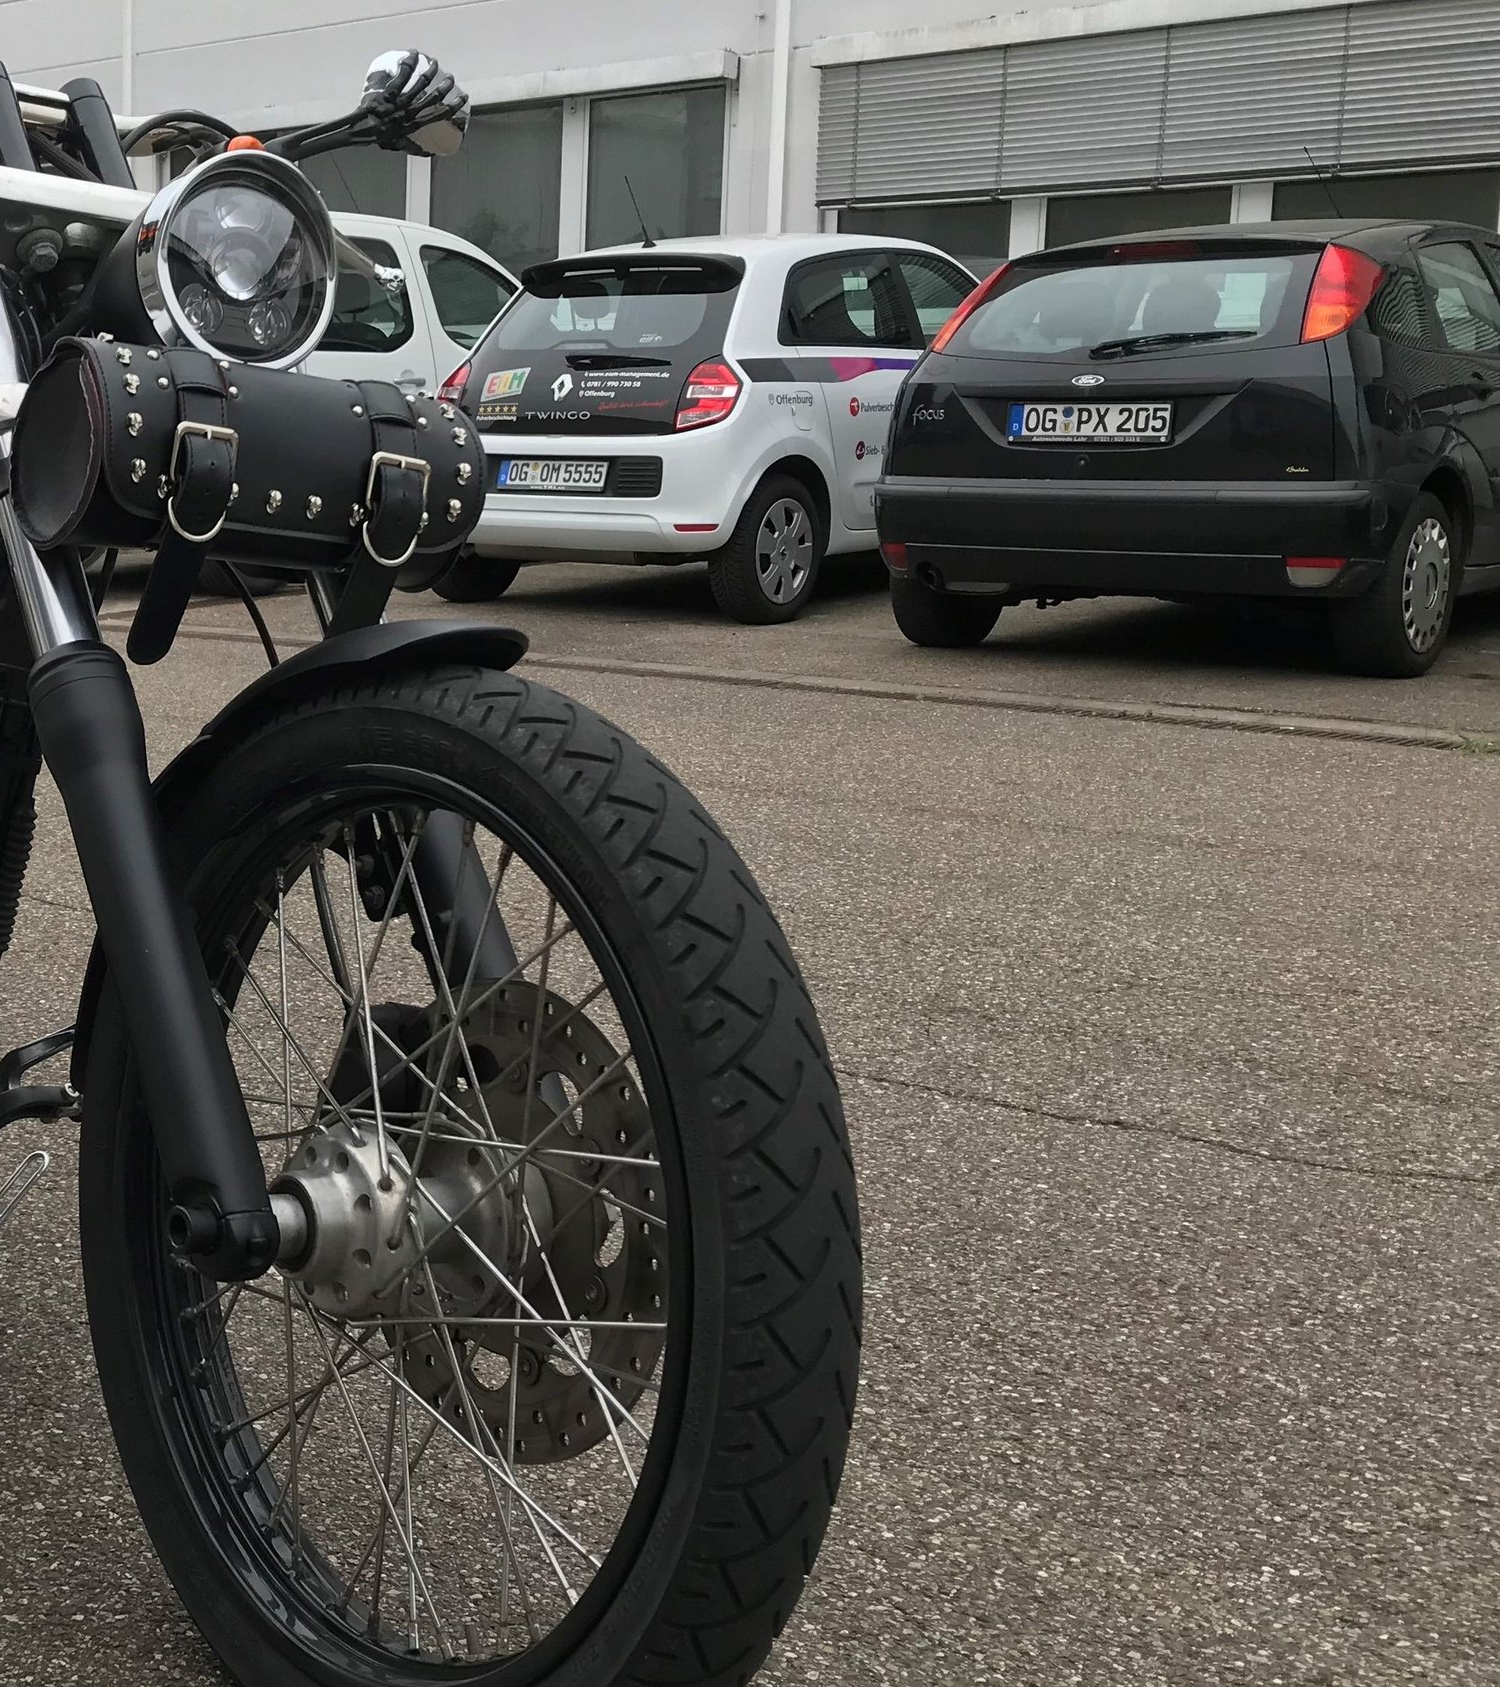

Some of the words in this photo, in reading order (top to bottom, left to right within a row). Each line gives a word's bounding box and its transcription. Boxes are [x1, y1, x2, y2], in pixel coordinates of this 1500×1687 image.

[584, 390, 615, 399] Offenburg
[776, 393, 814, 407] Offenburg
[525, 411, 591, 420] TWINGO
[1025, 407, 1058, 433] OG
[1076, 407, 1111, 433] PX
[1116, 407, 1169, 433] 205
[508, 463, 530, 482] OG
[539, 463, 562, 483] OM
[562, 463, 605, 484] 5555
